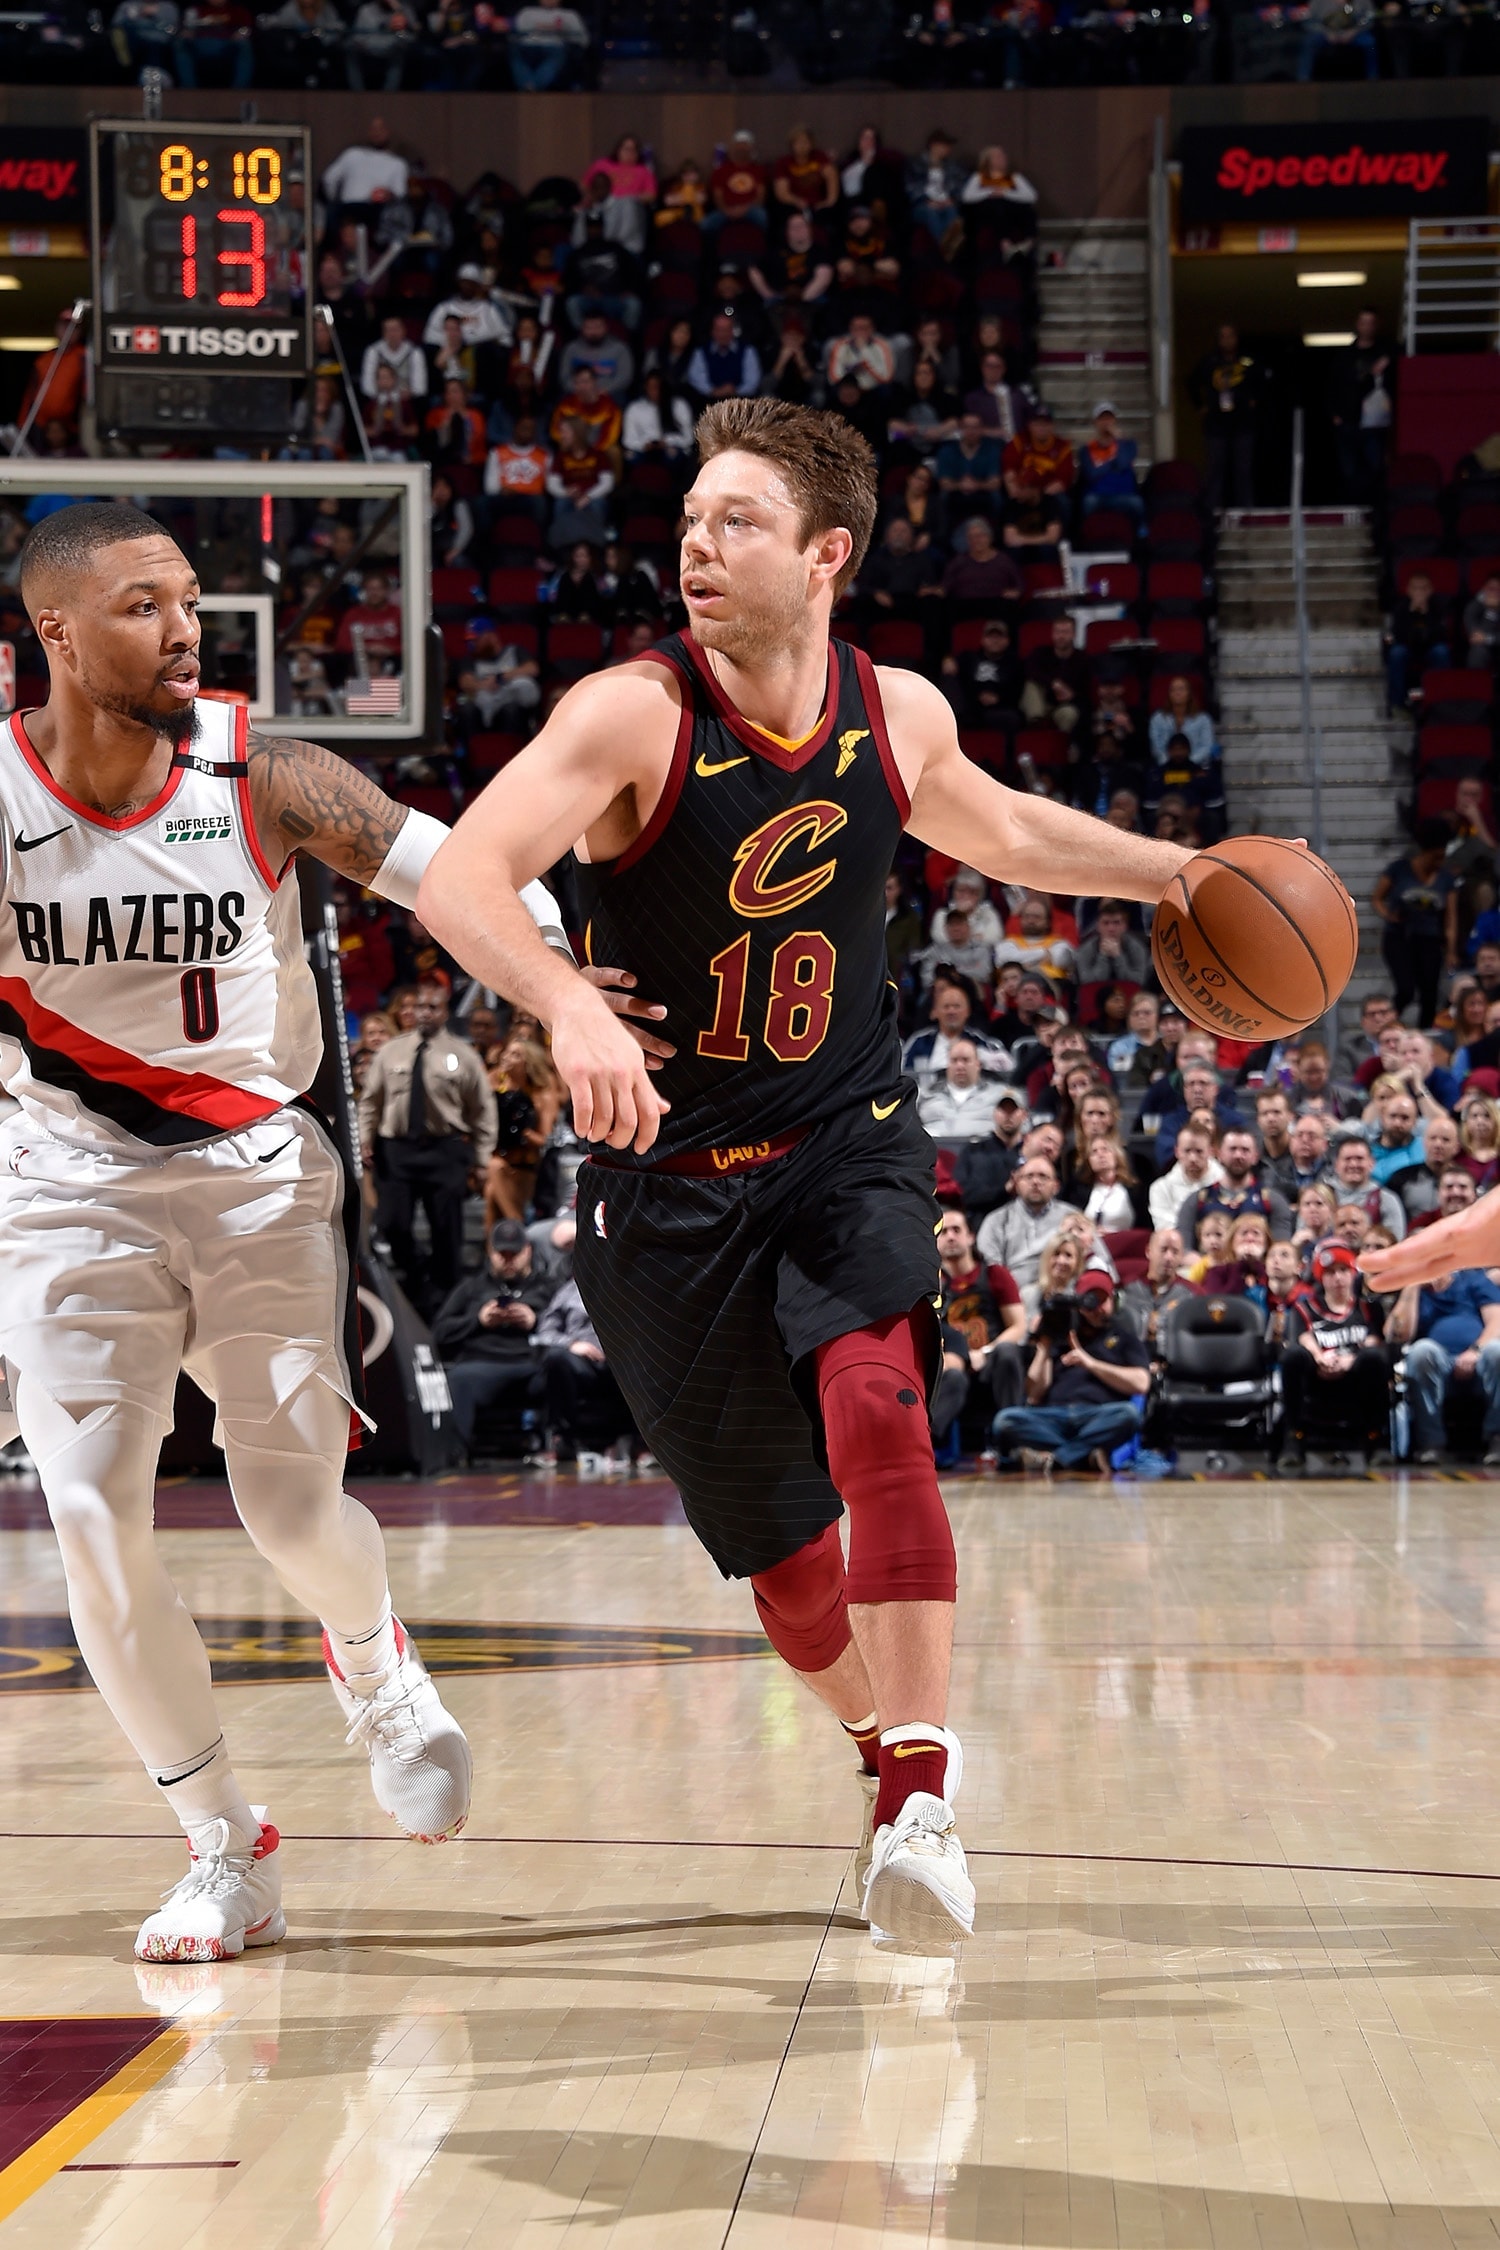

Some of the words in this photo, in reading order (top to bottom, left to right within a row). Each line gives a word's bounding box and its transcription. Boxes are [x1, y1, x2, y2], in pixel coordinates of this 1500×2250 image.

[160, 145, 281, 204] 8:10
[1217, 146, 1448, 196] Speedway
[181, 209, 265, 307] 13
[161, 326, 299, 357] TISSOT
[193, 758, 215, 775] PGA
[8, 891, 245, 966] BLAZERS
[180, 967, 220, 1044] 0
[697, 930, 837, 1063] 18
[1160, 920, 1262, 1036] SPALDING
